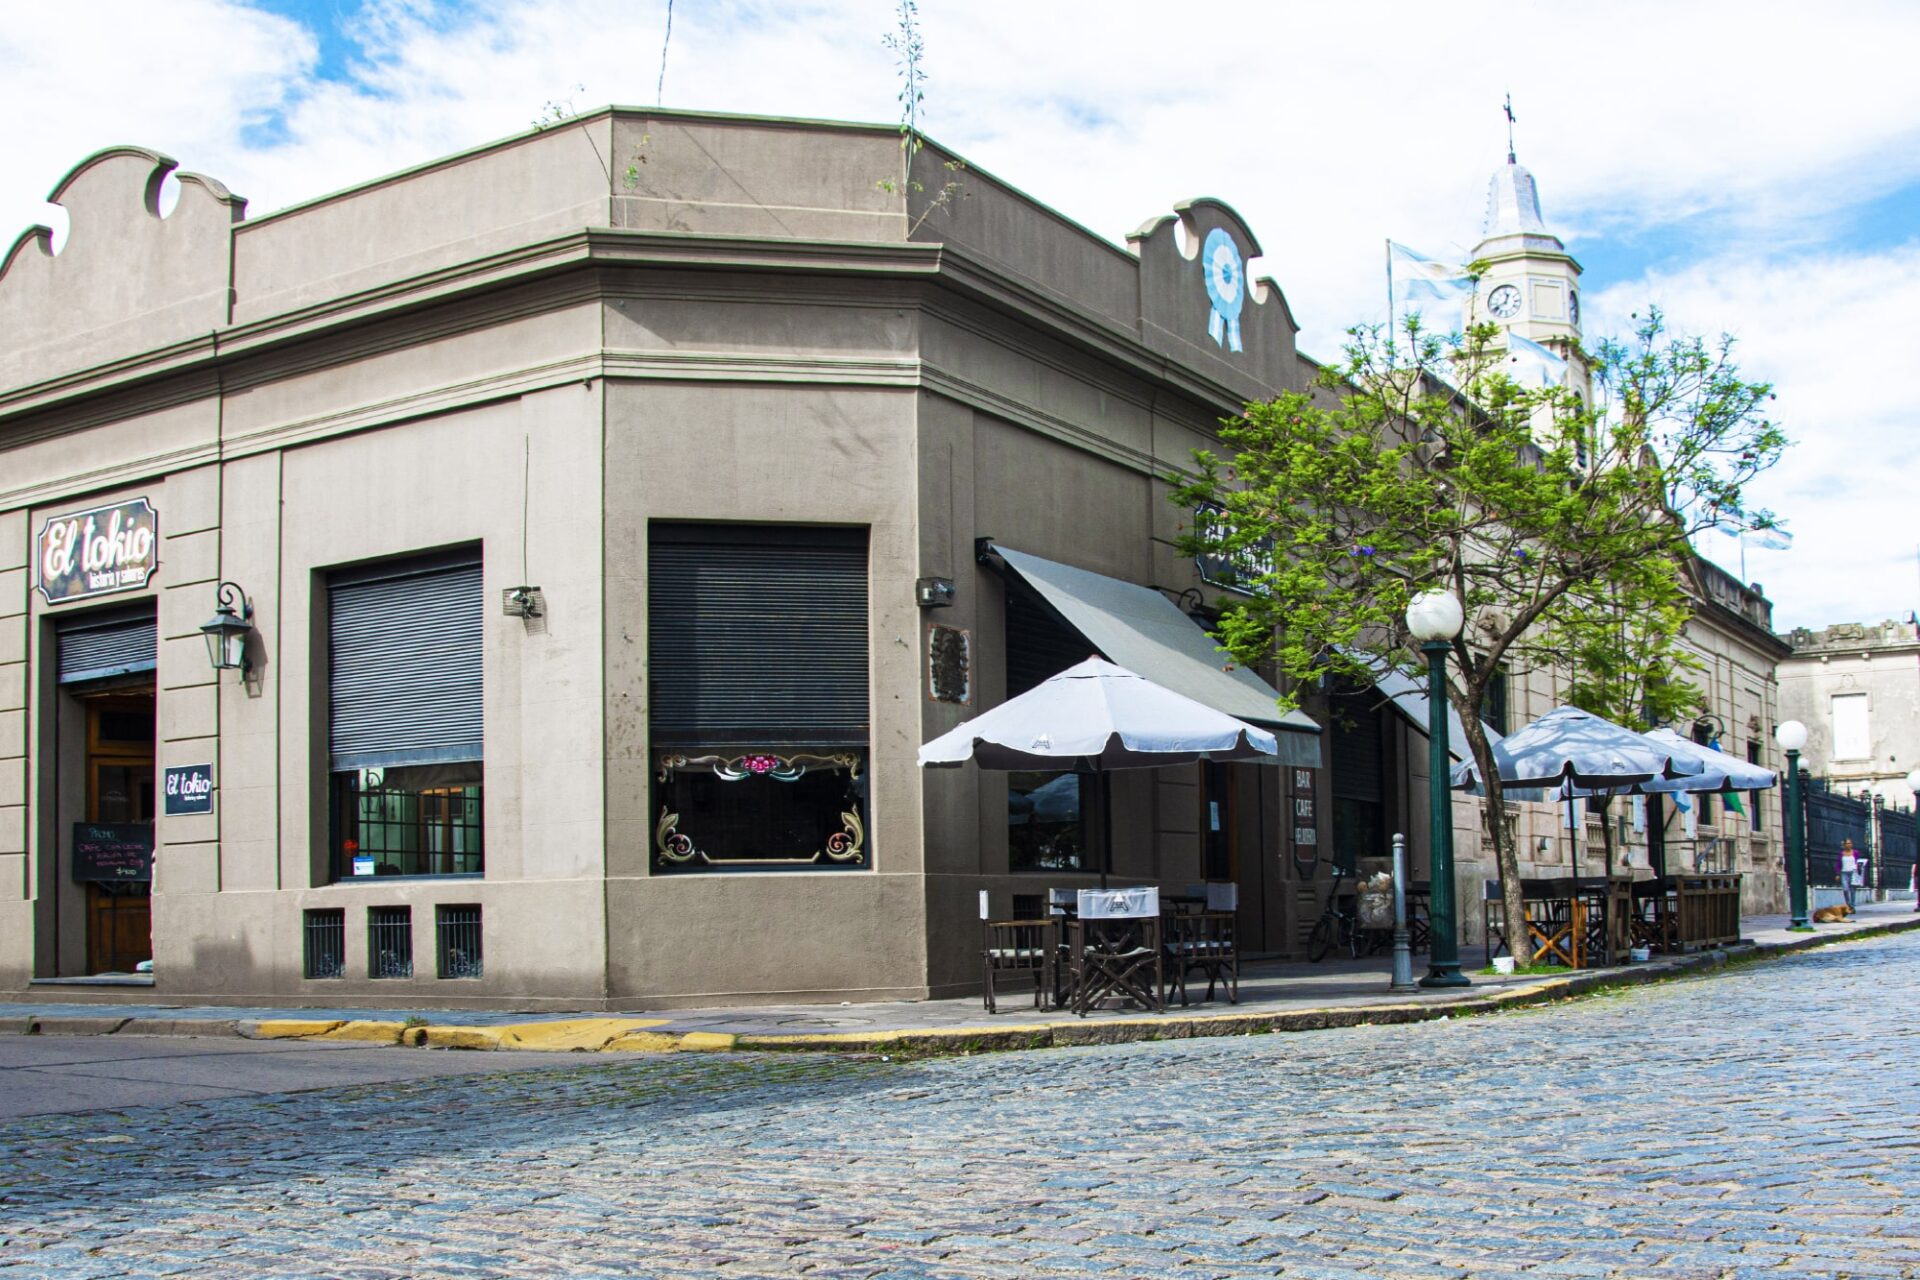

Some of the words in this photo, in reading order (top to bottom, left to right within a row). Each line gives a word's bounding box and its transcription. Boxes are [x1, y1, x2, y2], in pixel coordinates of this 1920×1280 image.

[44, 520, 77, 579] El
[82, 510, 154, 570] tokio
[167, 774, 179, 795] El
[180, 772, 212, 795] tokio
[1296, 770, 1311, 788] BAR
